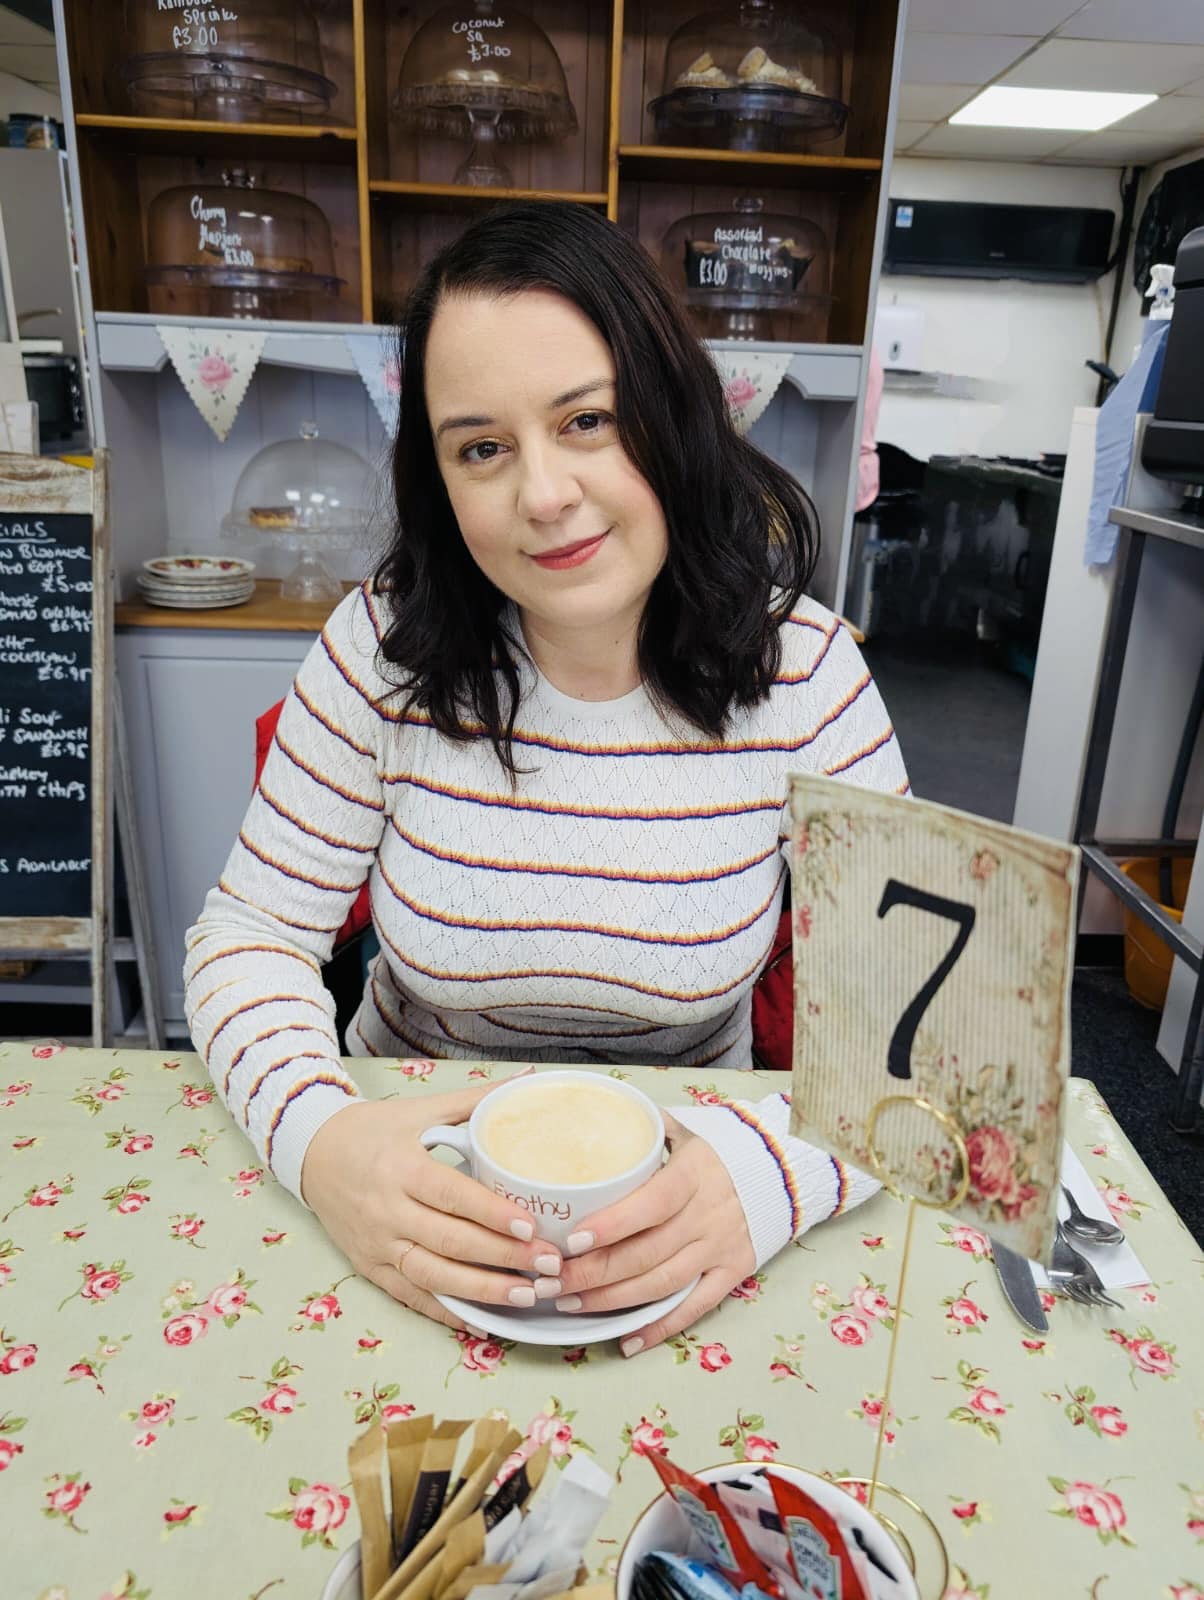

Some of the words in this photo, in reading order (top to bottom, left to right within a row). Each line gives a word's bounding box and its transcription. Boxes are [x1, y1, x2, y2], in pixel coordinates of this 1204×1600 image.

[172, 26, 218, 48] £3.00
[700, 258, 728, 286] £3.00
[877, 876, 976, 1080] 7
